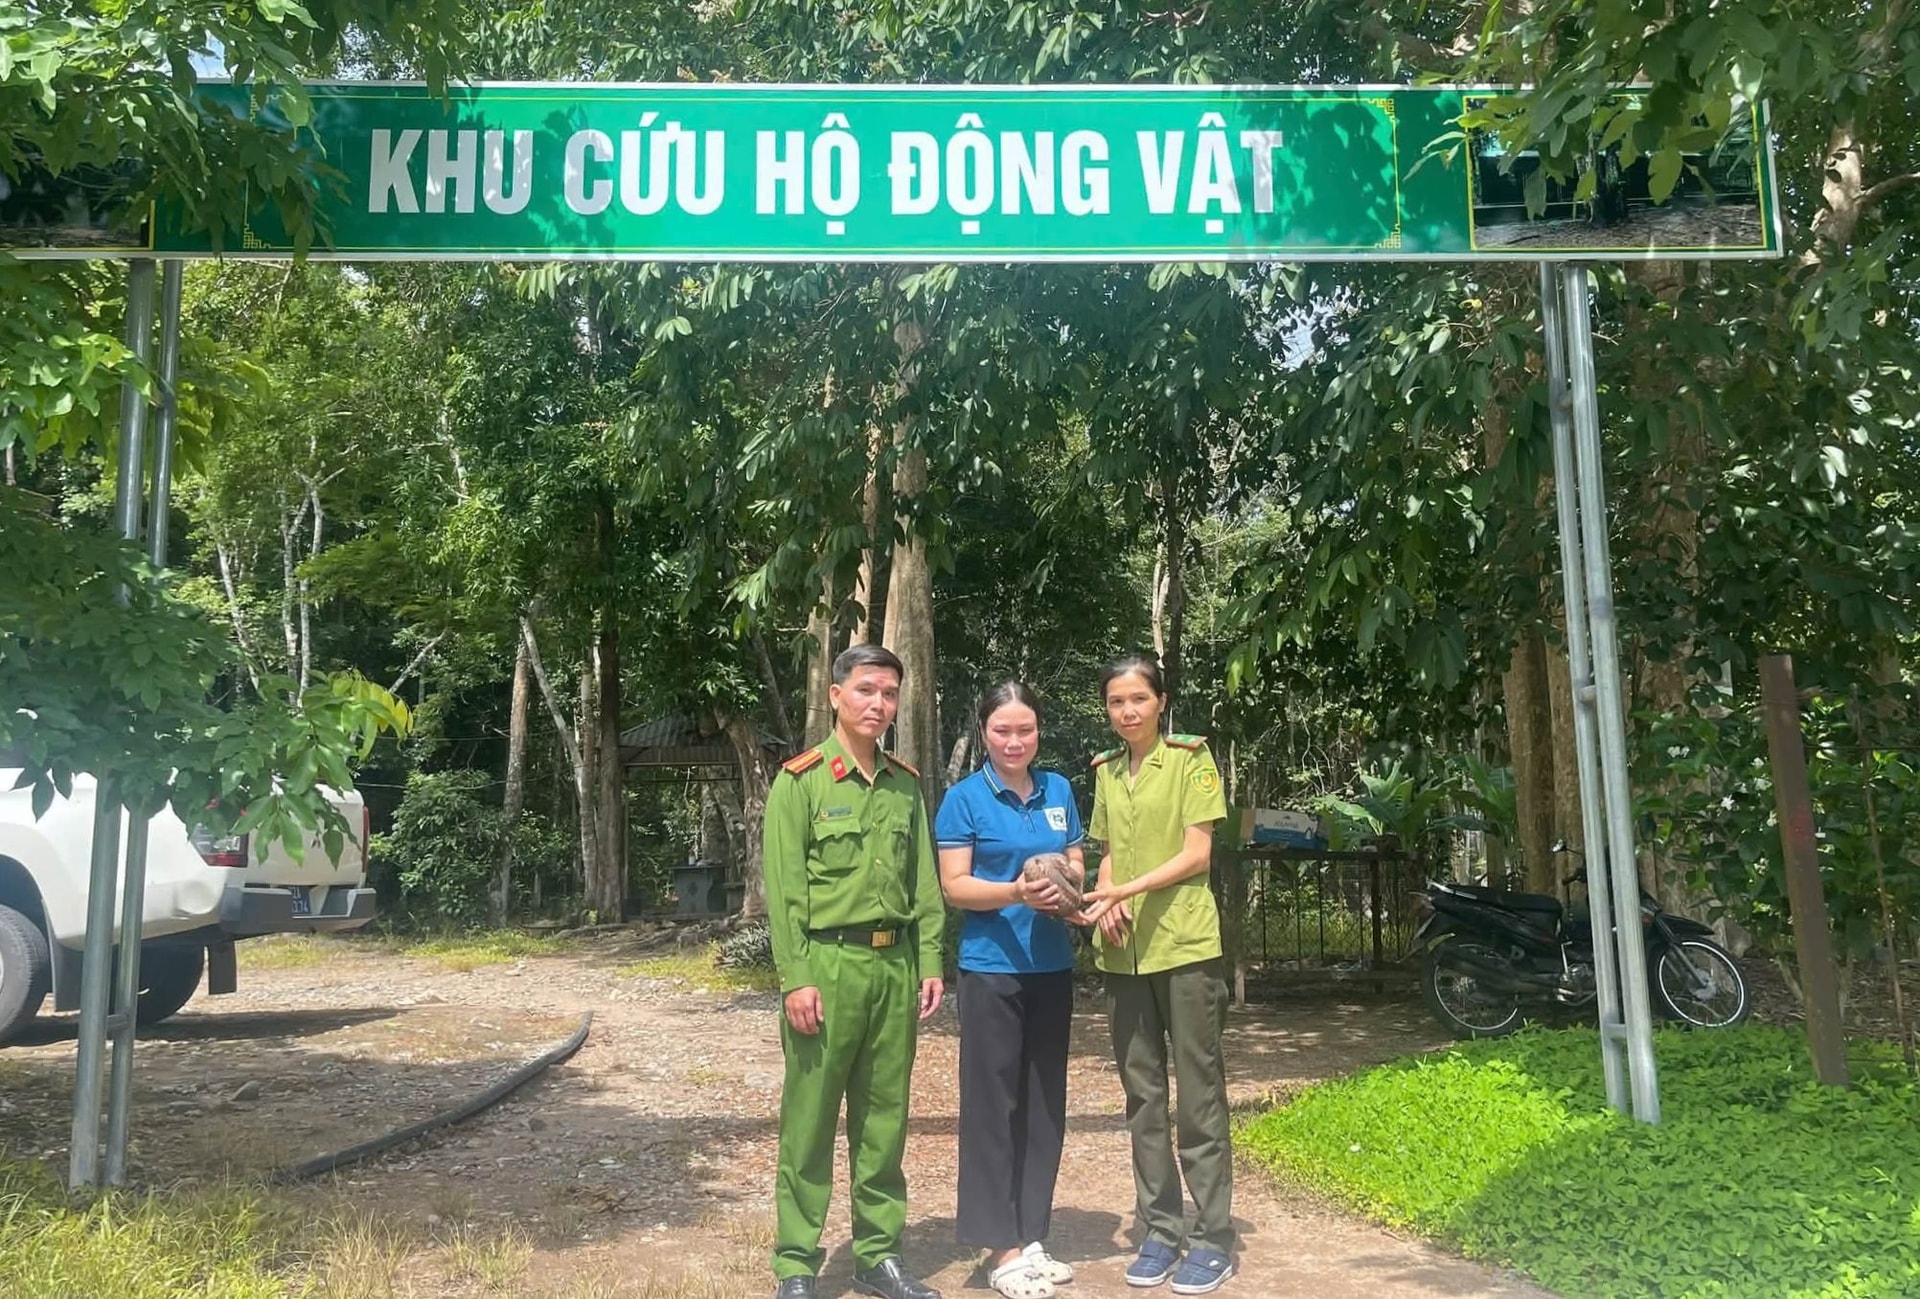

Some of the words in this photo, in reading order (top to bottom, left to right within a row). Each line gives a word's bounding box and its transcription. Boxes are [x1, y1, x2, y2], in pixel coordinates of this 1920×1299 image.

[369, 129, 533, 214] KHU
[565, 112, 725, 215] CỨU
[756, 113, 861, 235] HỘ
[887, 112, 1110, 235] ĐỘNG
[1137, 112, 1283, 234] VẬT
